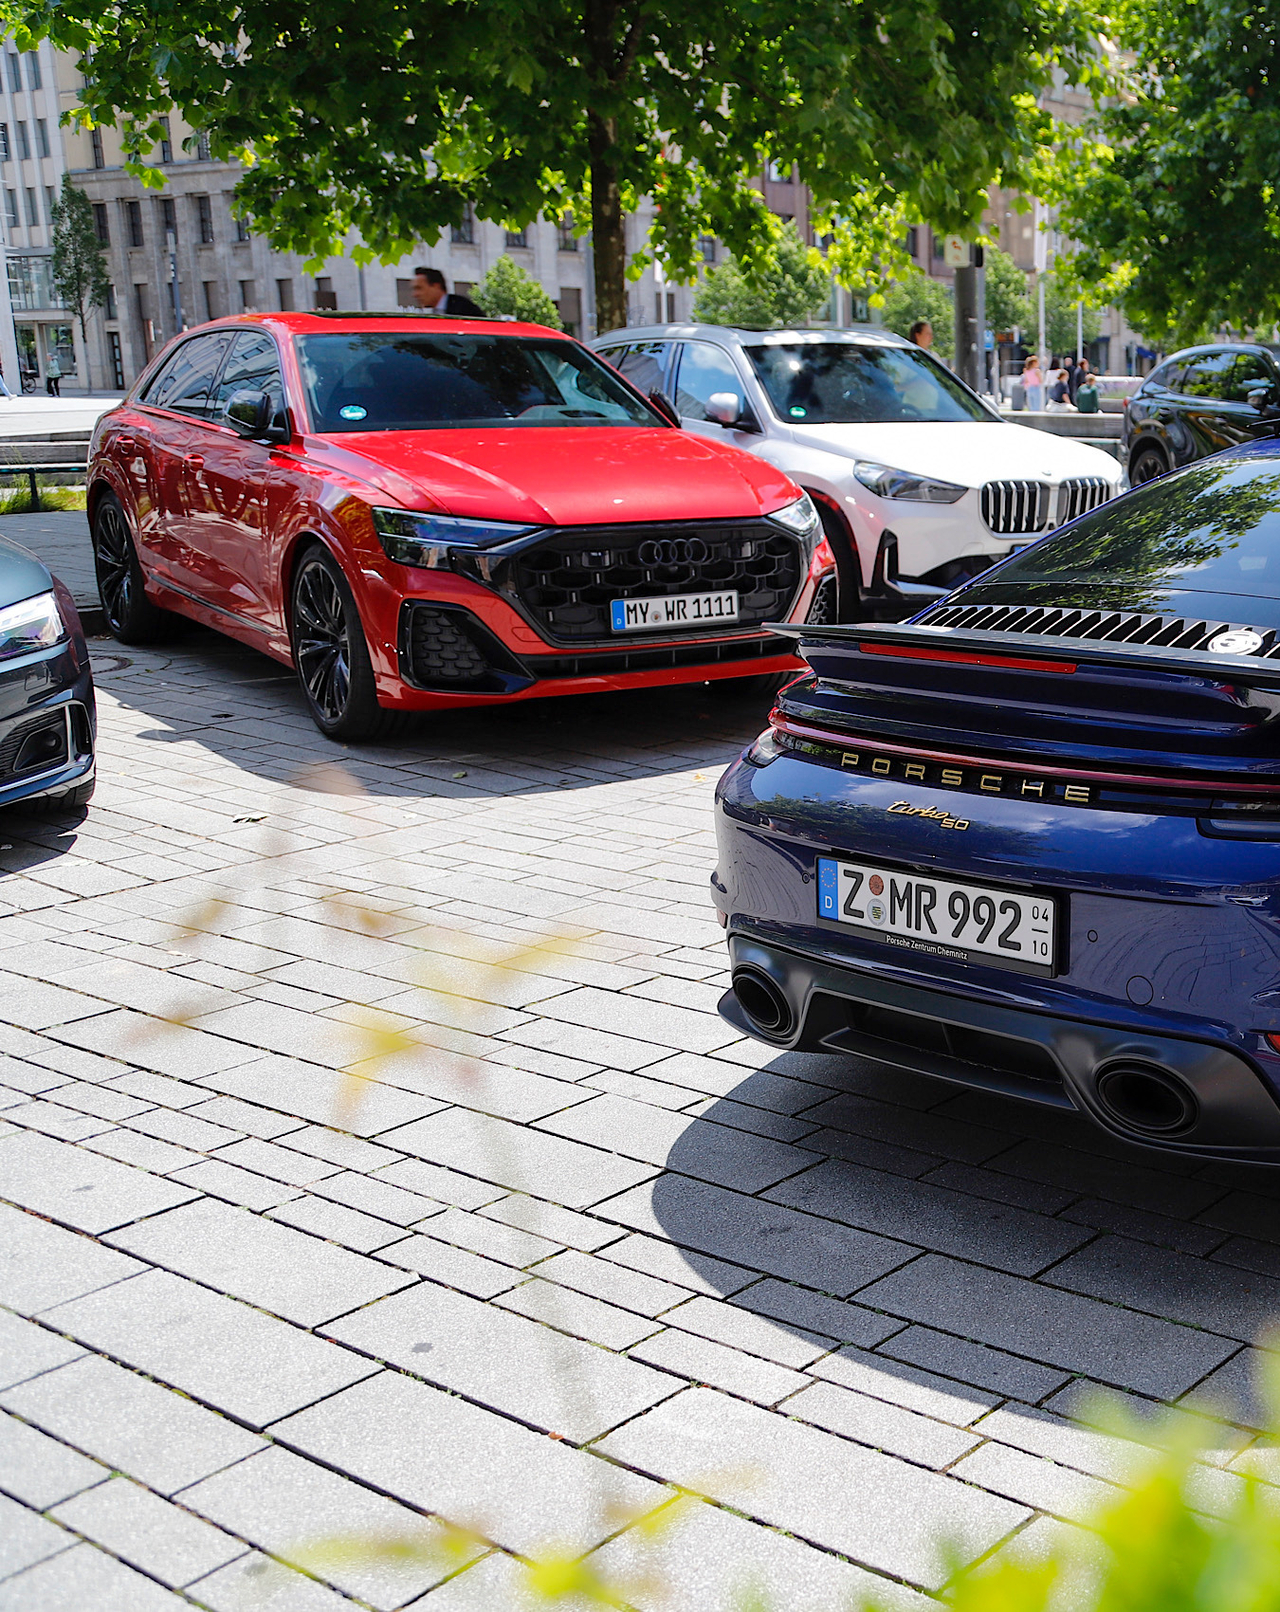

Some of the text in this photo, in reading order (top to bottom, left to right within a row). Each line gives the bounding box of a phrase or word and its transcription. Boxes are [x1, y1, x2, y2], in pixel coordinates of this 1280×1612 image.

[626, 595, 736, 625] MY WR 1111
[841, 752, 1090, 802] PORSCHE
[886, 801, 970, 831] turbo 50
[824, 896, 833, 909] D
[843, 869, 1022, 952] Z MR 992
[1032, 905, 1049, 922] 04
[886, 934, 968, 960] Porsche Zentrum Chemnitz
[1032, 940, 1048, 957] 10
